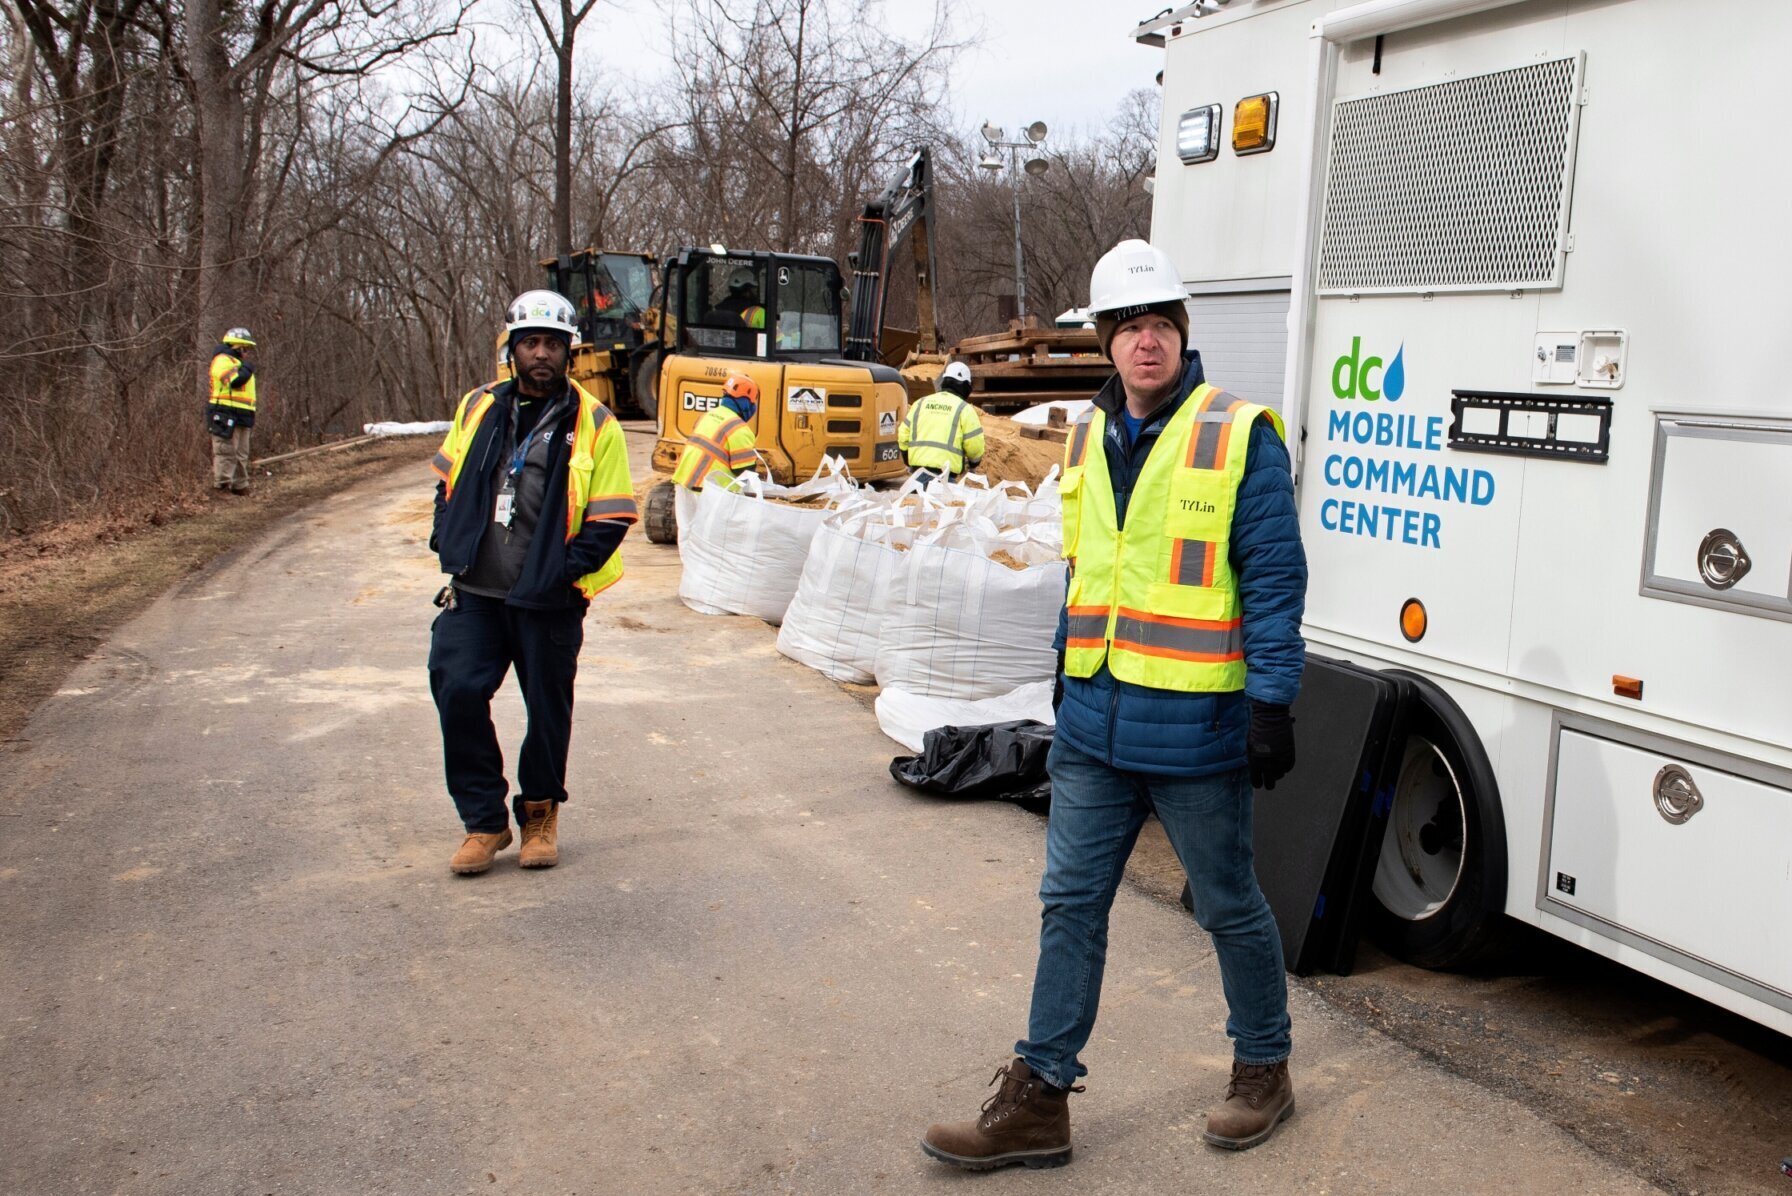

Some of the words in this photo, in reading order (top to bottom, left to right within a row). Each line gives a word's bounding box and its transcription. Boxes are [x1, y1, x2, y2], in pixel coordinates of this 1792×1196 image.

[706, 257, 726, 265] JOHN
[728, 259, 754, 267] DEERE
[531, 308, 545, 317] dc
[1332, 336, 1383, 401] dc
[683, 391, 722, 412] DEE
[925, 403, 953, 412] ANCHOR
[1328, 409, 1443, 451] MOBILE
[1324, 454, 1496, 506] COMMAND
[1180, 499, 1216, 513] TYLin
[1320, 498, 1441, 549] CENTER
